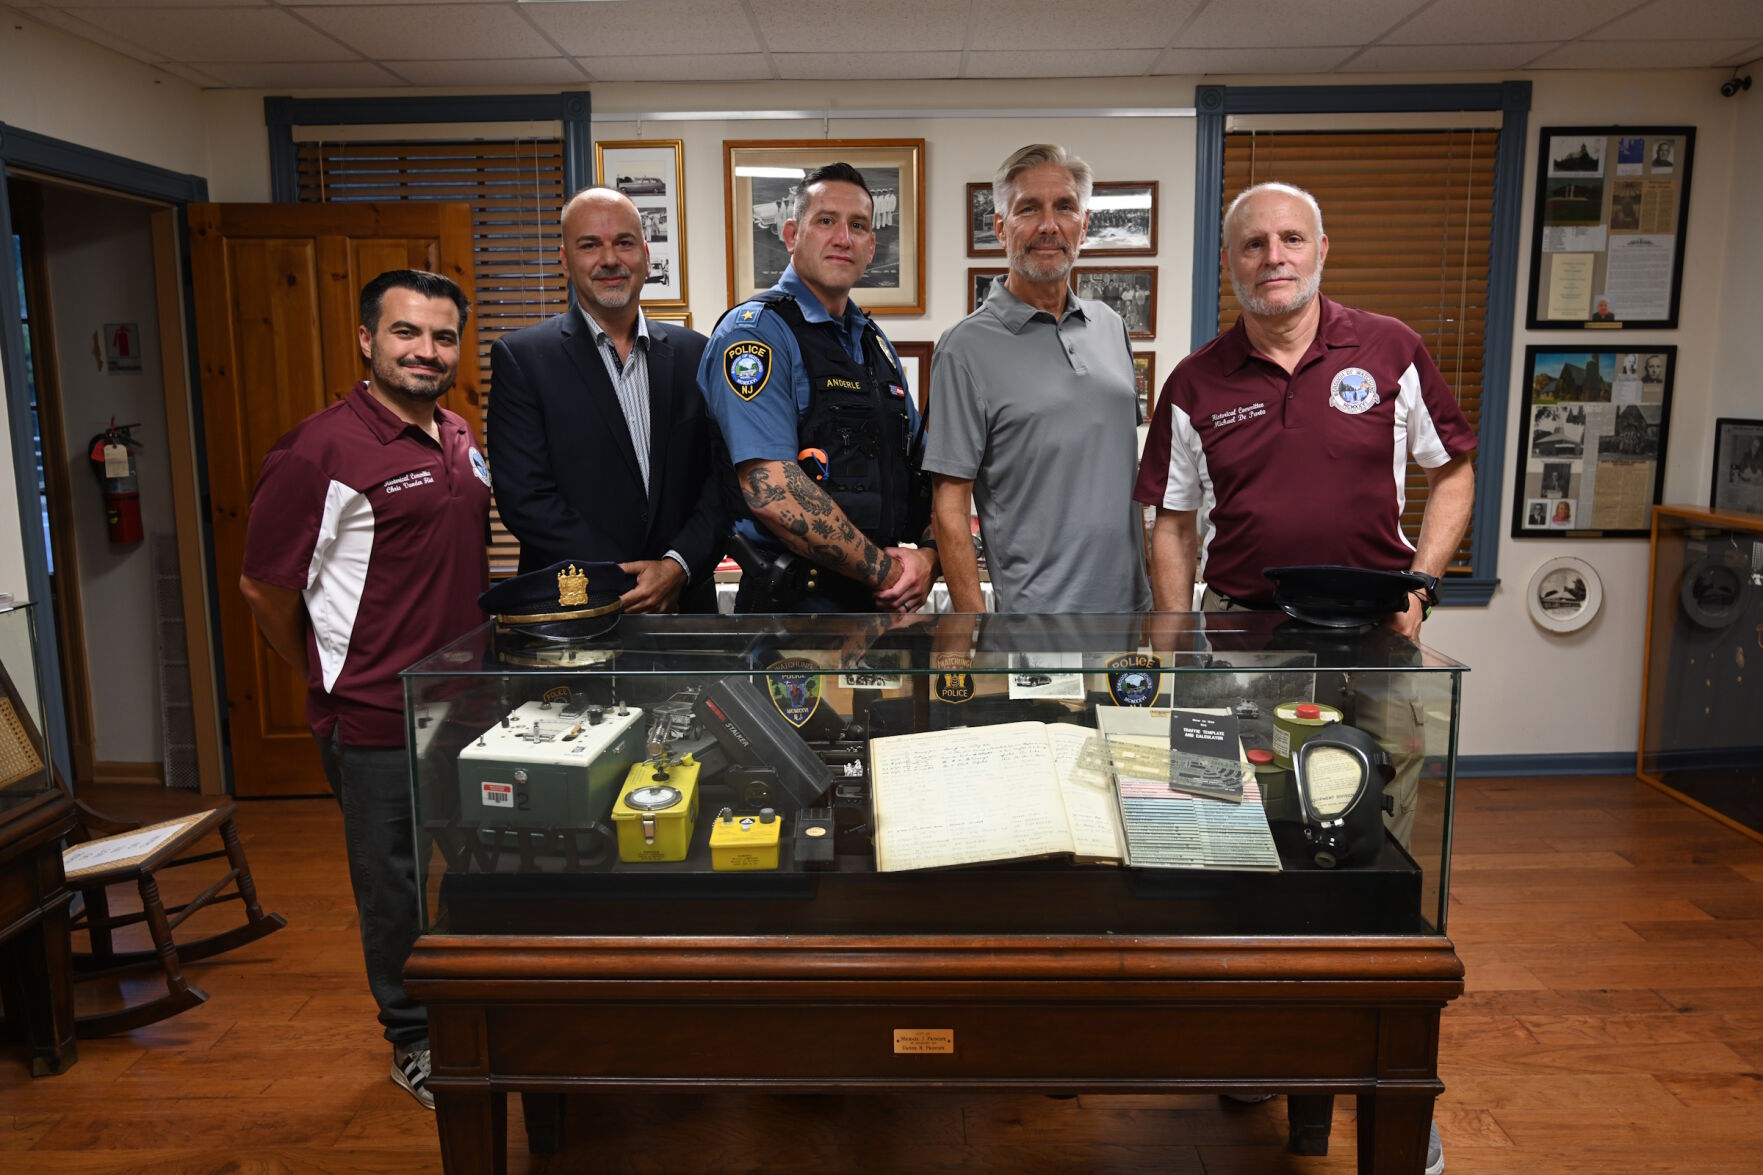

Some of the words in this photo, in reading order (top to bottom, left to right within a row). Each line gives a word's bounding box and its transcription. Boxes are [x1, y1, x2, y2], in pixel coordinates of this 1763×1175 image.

[728, 345, 766, 359] POLICE
[741, 385, 754, 395] NJ
[826, 379, 861, 391] ANDERLE
[1237, 402, 1264, 414] Committee
[1112, 656, 1155, 674] POLICE
[942, 689, 968, 698] POLICE
[724, 722, 749, 747] STALKER
